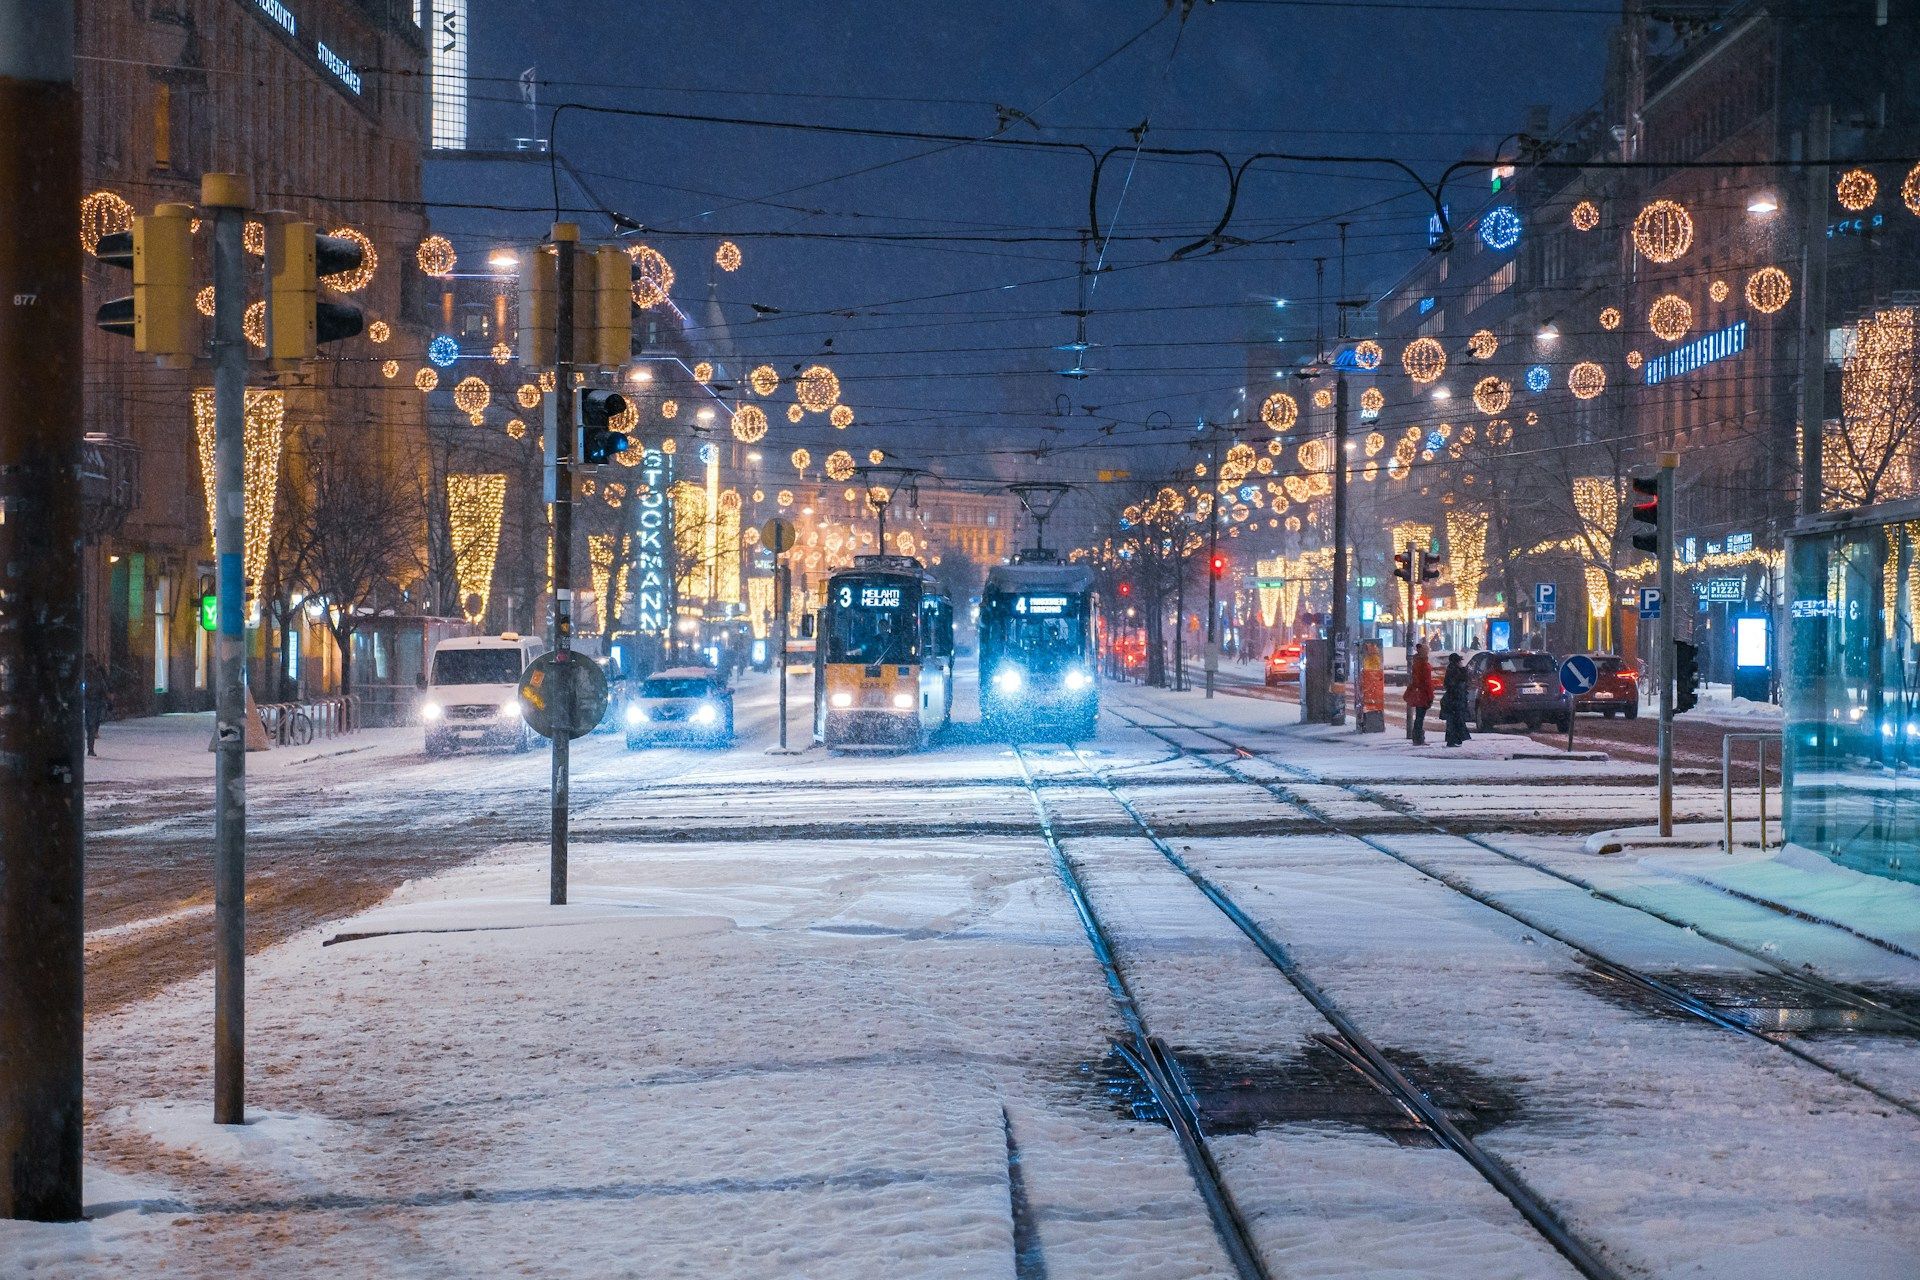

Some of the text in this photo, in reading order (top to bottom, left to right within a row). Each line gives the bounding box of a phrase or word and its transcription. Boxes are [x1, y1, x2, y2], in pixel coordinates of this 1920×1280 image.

[254, 0, 295, 36] LASKUNTA
[13, 294, 37, 306] 877
[640, 449, 663, 630] STOCKMANN
[840, 587, 852, 608] 3
[1541, 585, 1553, 601] P
[1644, 590, 1660, 609] P
[1016, 597, 1027, 614] 4
